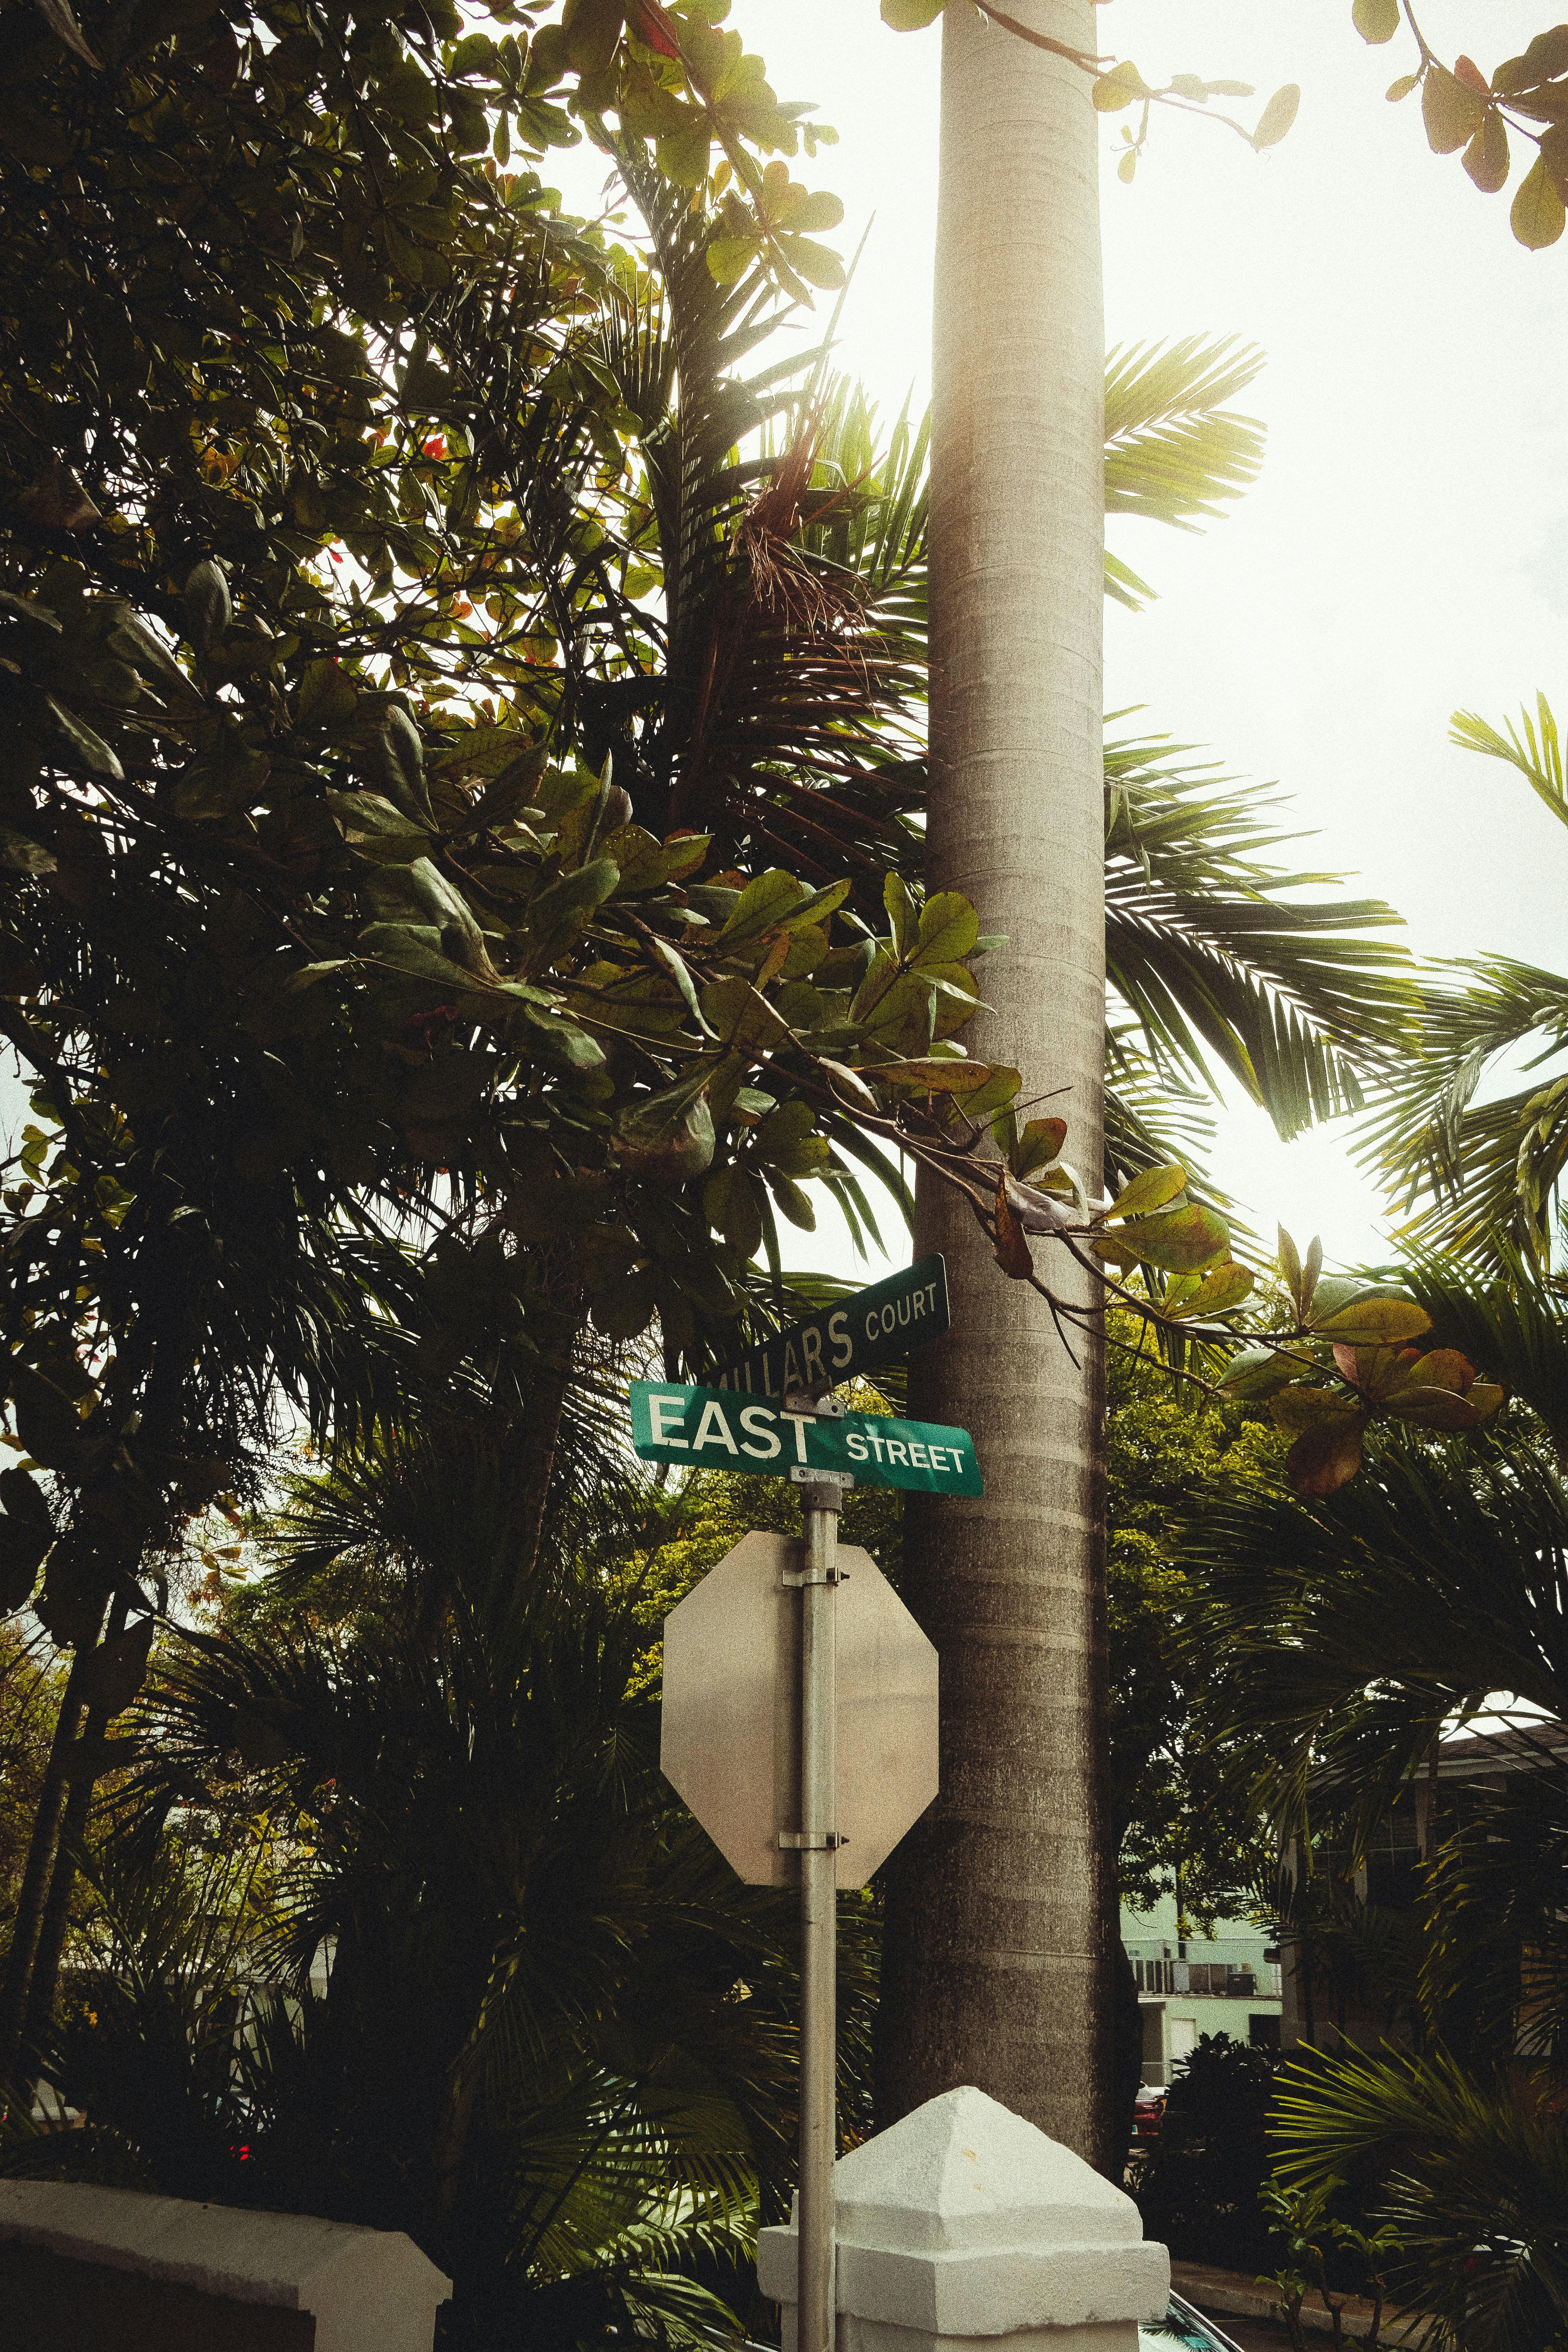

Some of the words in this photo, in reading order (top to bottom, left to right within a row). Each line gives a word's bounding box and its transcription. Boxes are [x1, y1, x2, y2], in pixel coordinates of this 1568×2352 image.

[866, 1282, 936, 1341] COURT
[648, 1394, 816, 1463] EAST
[846, 1433, 965, 1474] STREET
